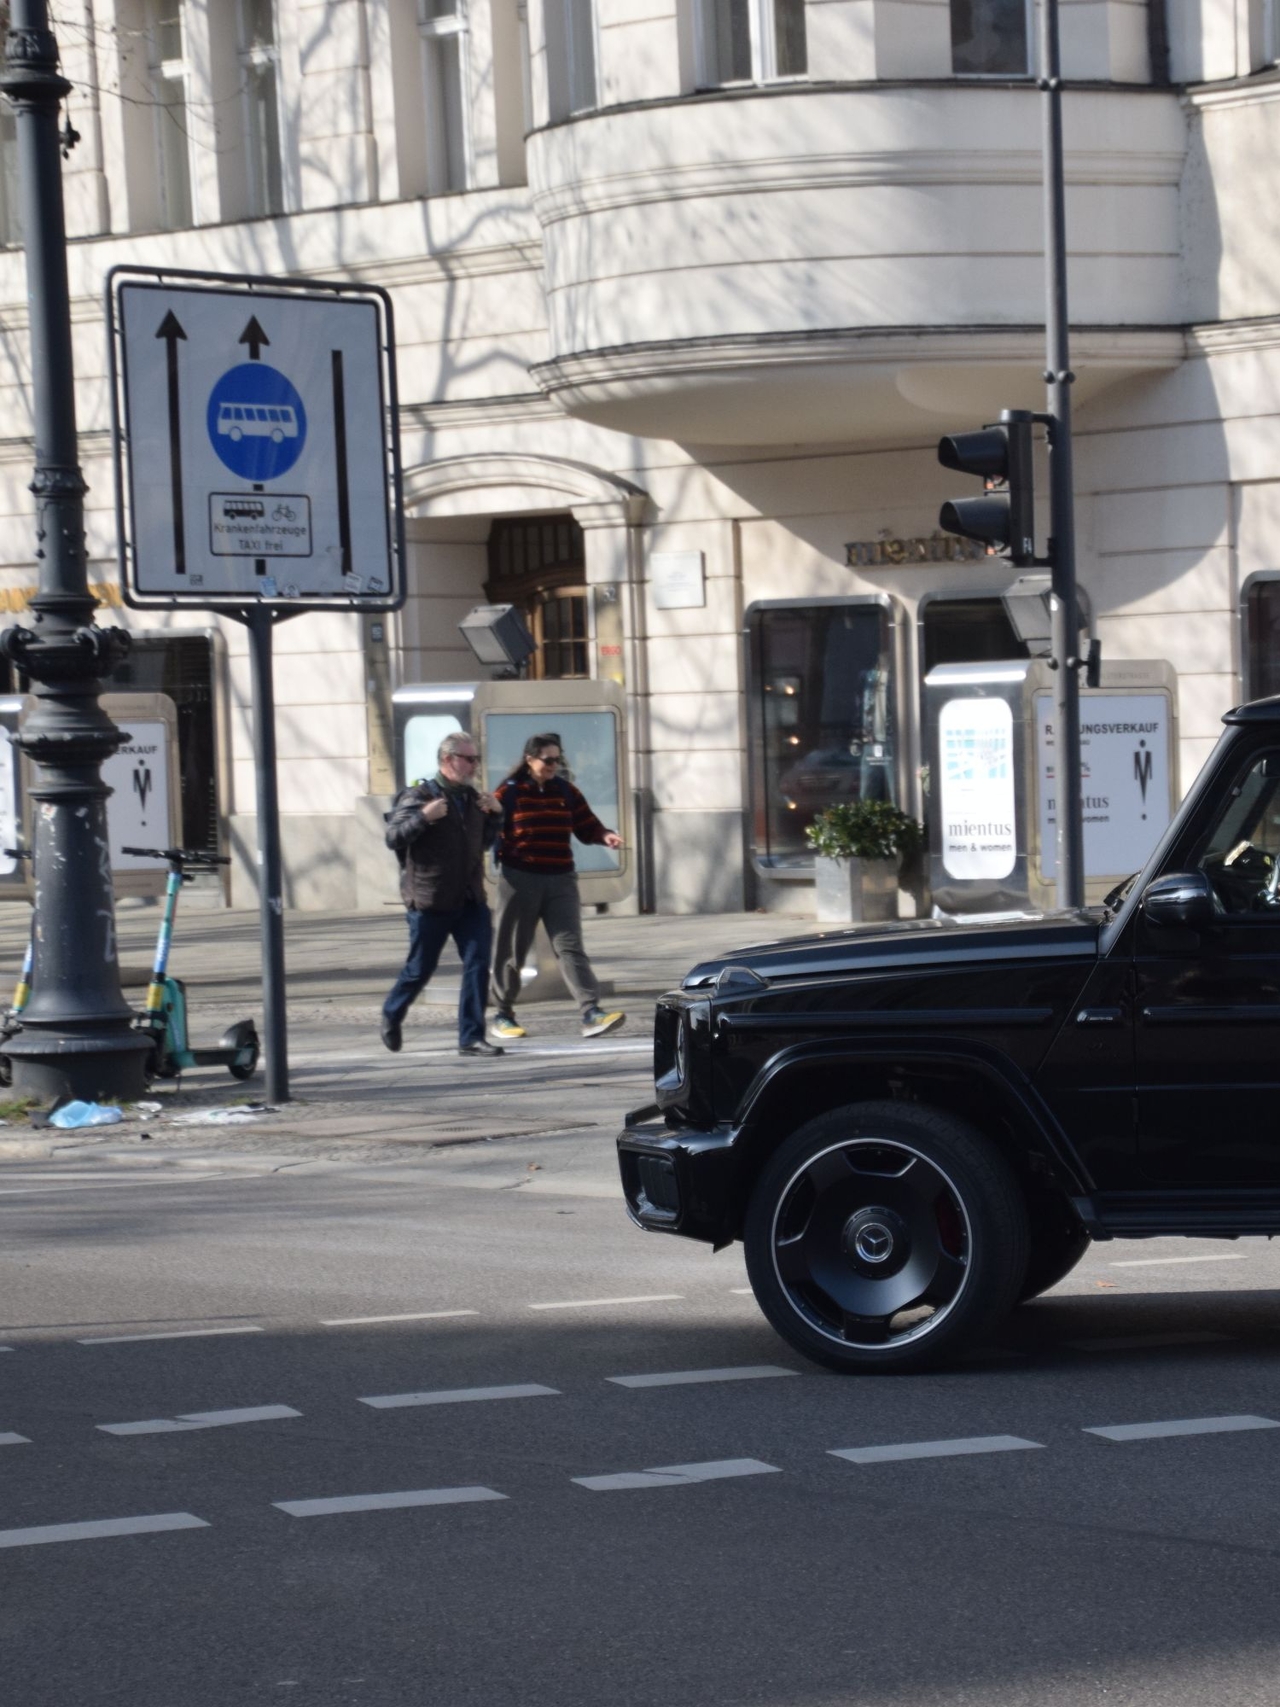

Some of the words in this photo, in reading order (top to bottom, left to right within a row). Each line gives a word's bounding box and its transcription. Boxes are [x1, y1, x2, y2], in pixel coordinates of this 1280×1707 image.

[214, 524, 307, 537] Krankenfahrzeuge
[239, 540, 260, 550] TAXI
[265, 541, 283, 550] frei
[1045, 723, 1159, 735] RUNGSVERKAUF
[948, 820, 1012, 836] mientus
[949, 843, 967, 852] men
[981, 843, 1012, 852] women
